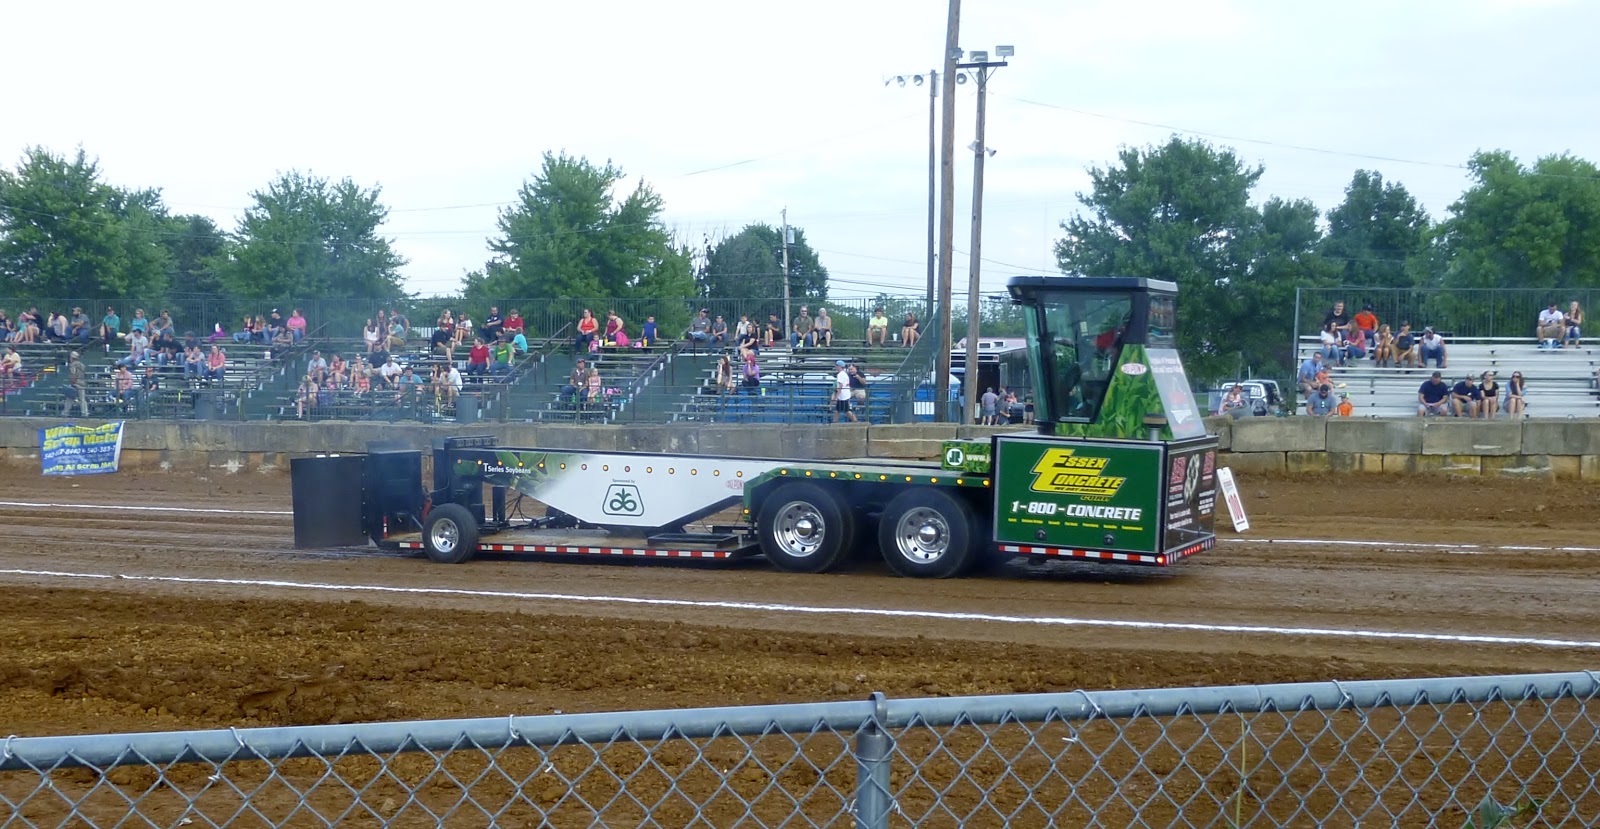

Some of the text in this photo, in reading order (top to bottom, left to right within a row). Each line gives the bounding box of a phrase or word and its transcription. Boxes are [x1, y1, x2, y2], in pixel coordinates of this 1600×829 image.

[43, 436, 81, 451] Scrap
[505, 466, 531, 475] Soybeans
[1031, 448, 1110, 475] ESSEX
[1030, 473, 1125, 494] CONCRETE
